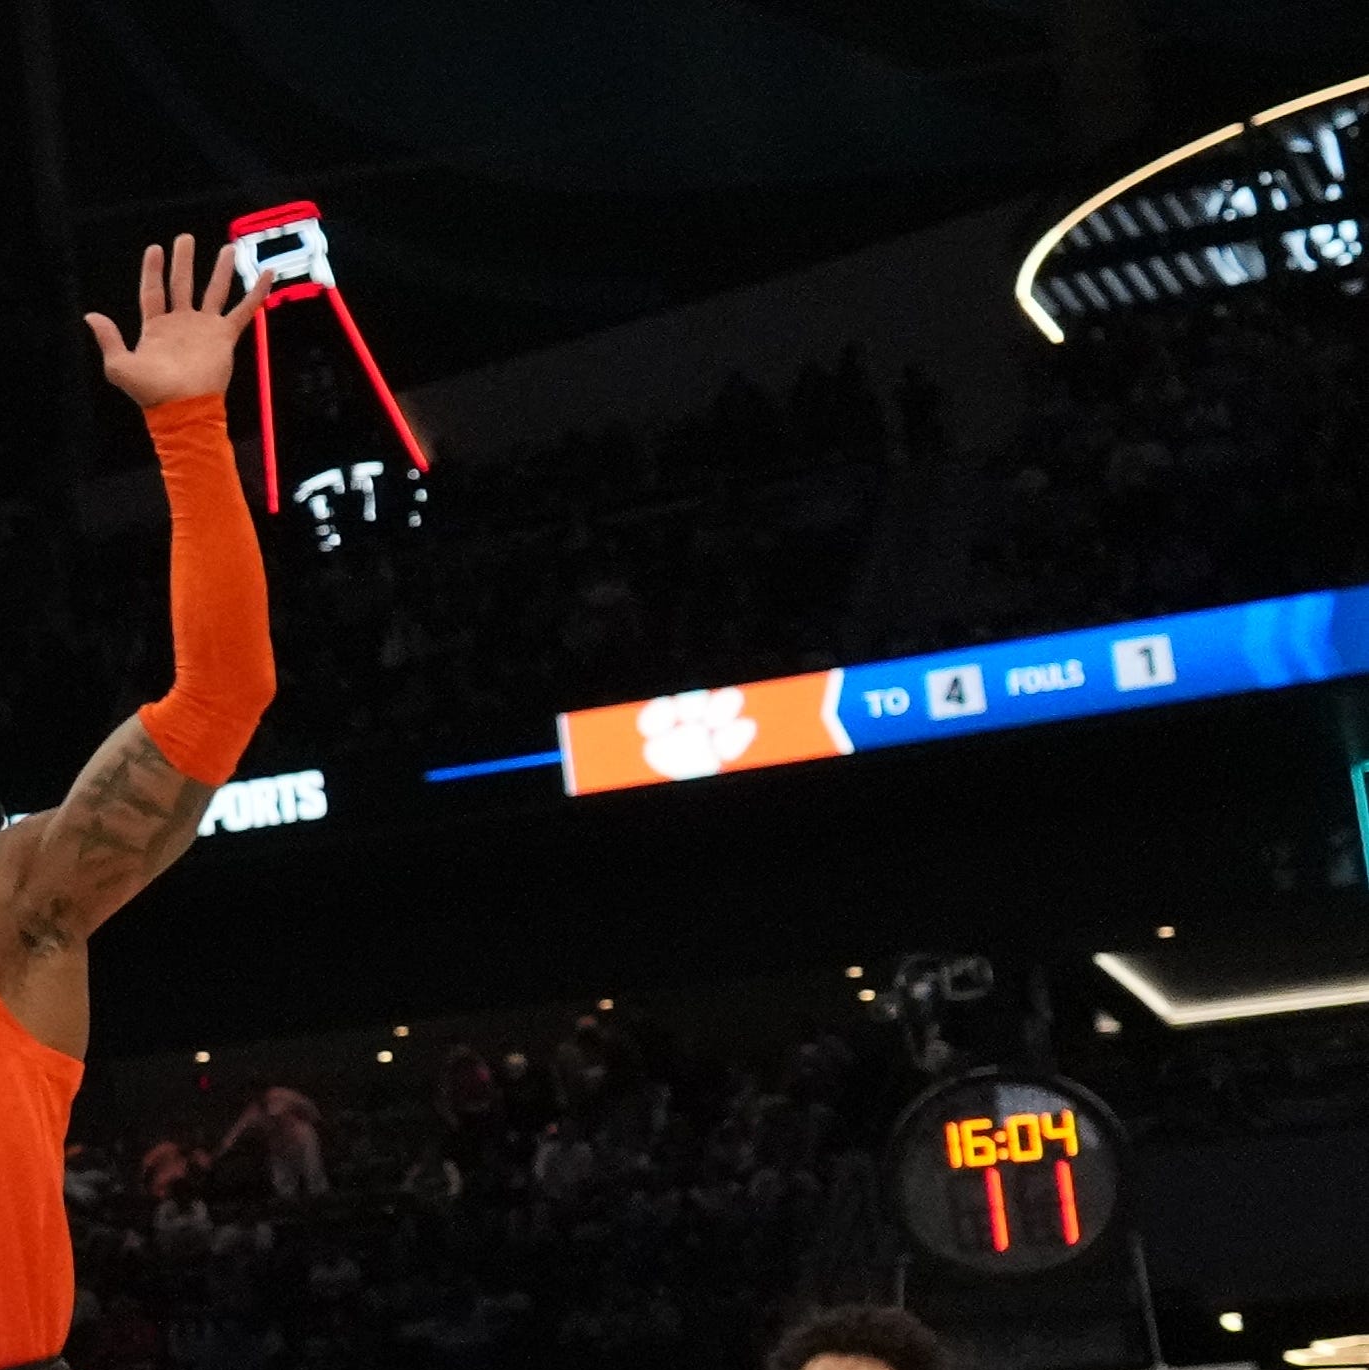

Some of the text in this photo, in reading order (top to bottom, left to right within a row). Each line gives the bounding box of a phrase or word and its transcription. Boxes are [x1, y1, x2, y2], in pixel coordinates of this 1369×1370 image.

[862, 646, 1159, 719] TO 4 FOULS 1
[944, 1108, 1079, 1170] 16:04
[984, 1159, 1081, 1253] 11
